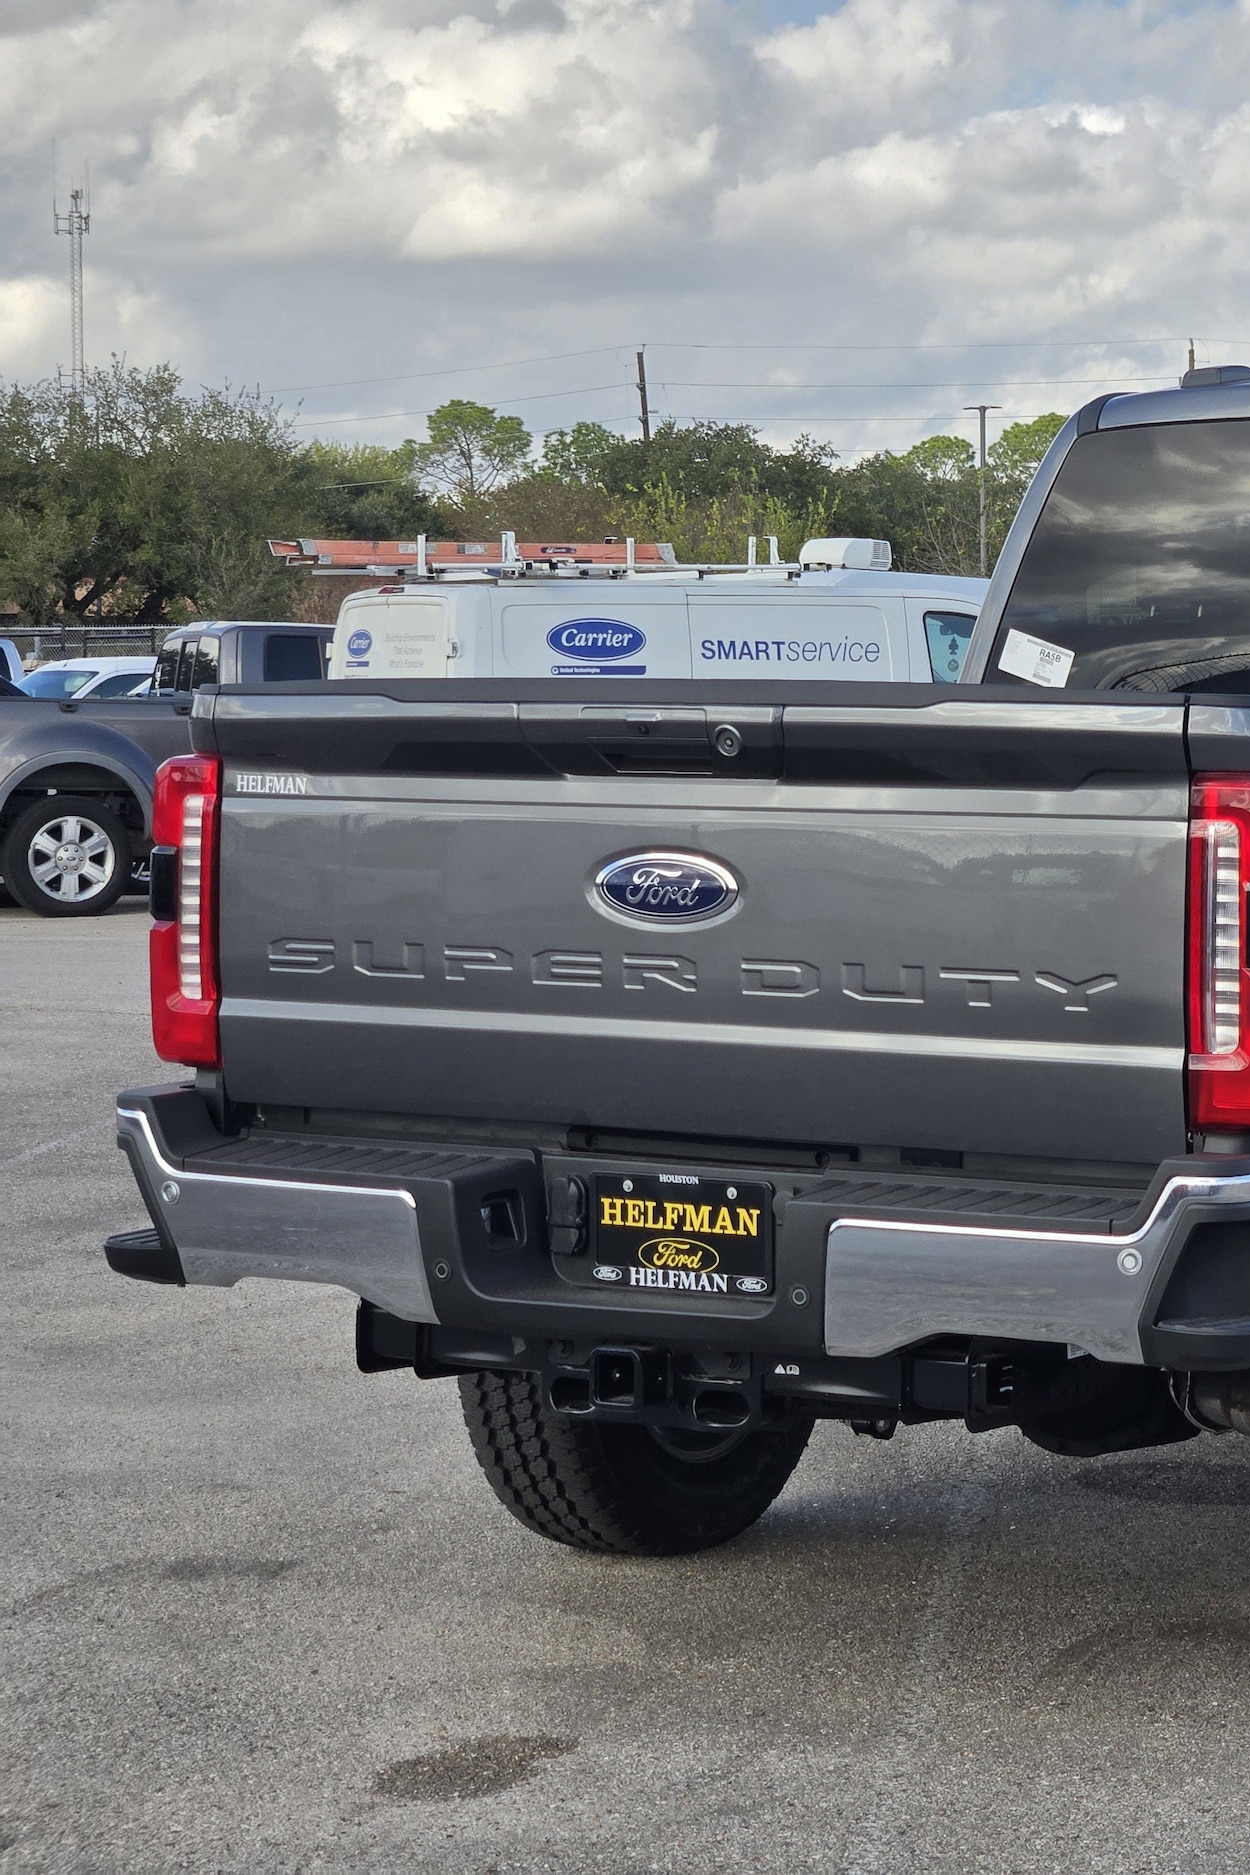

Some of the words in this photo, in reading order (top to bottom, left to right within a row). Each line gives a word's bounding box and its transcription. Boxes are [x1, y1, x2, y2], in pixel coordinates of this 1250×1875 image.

[350, 636, 370, 649] Carrier
[560, 628, 634, 647] Carrier
[236, 774, 308, 795] HELFMAN
[625, 867, 701, 907] Ford
[268, 937, 698, 993] SUPER
[740, 957, 1118, 1012] DUTY
[659, 1173, 700, 1185] HOUSTON
[600, 1197, 761, 1237] HELFMAN
[652, 1240, 703, 1270] Ford
[629, 1266, 729, 1293] HELFMAN
